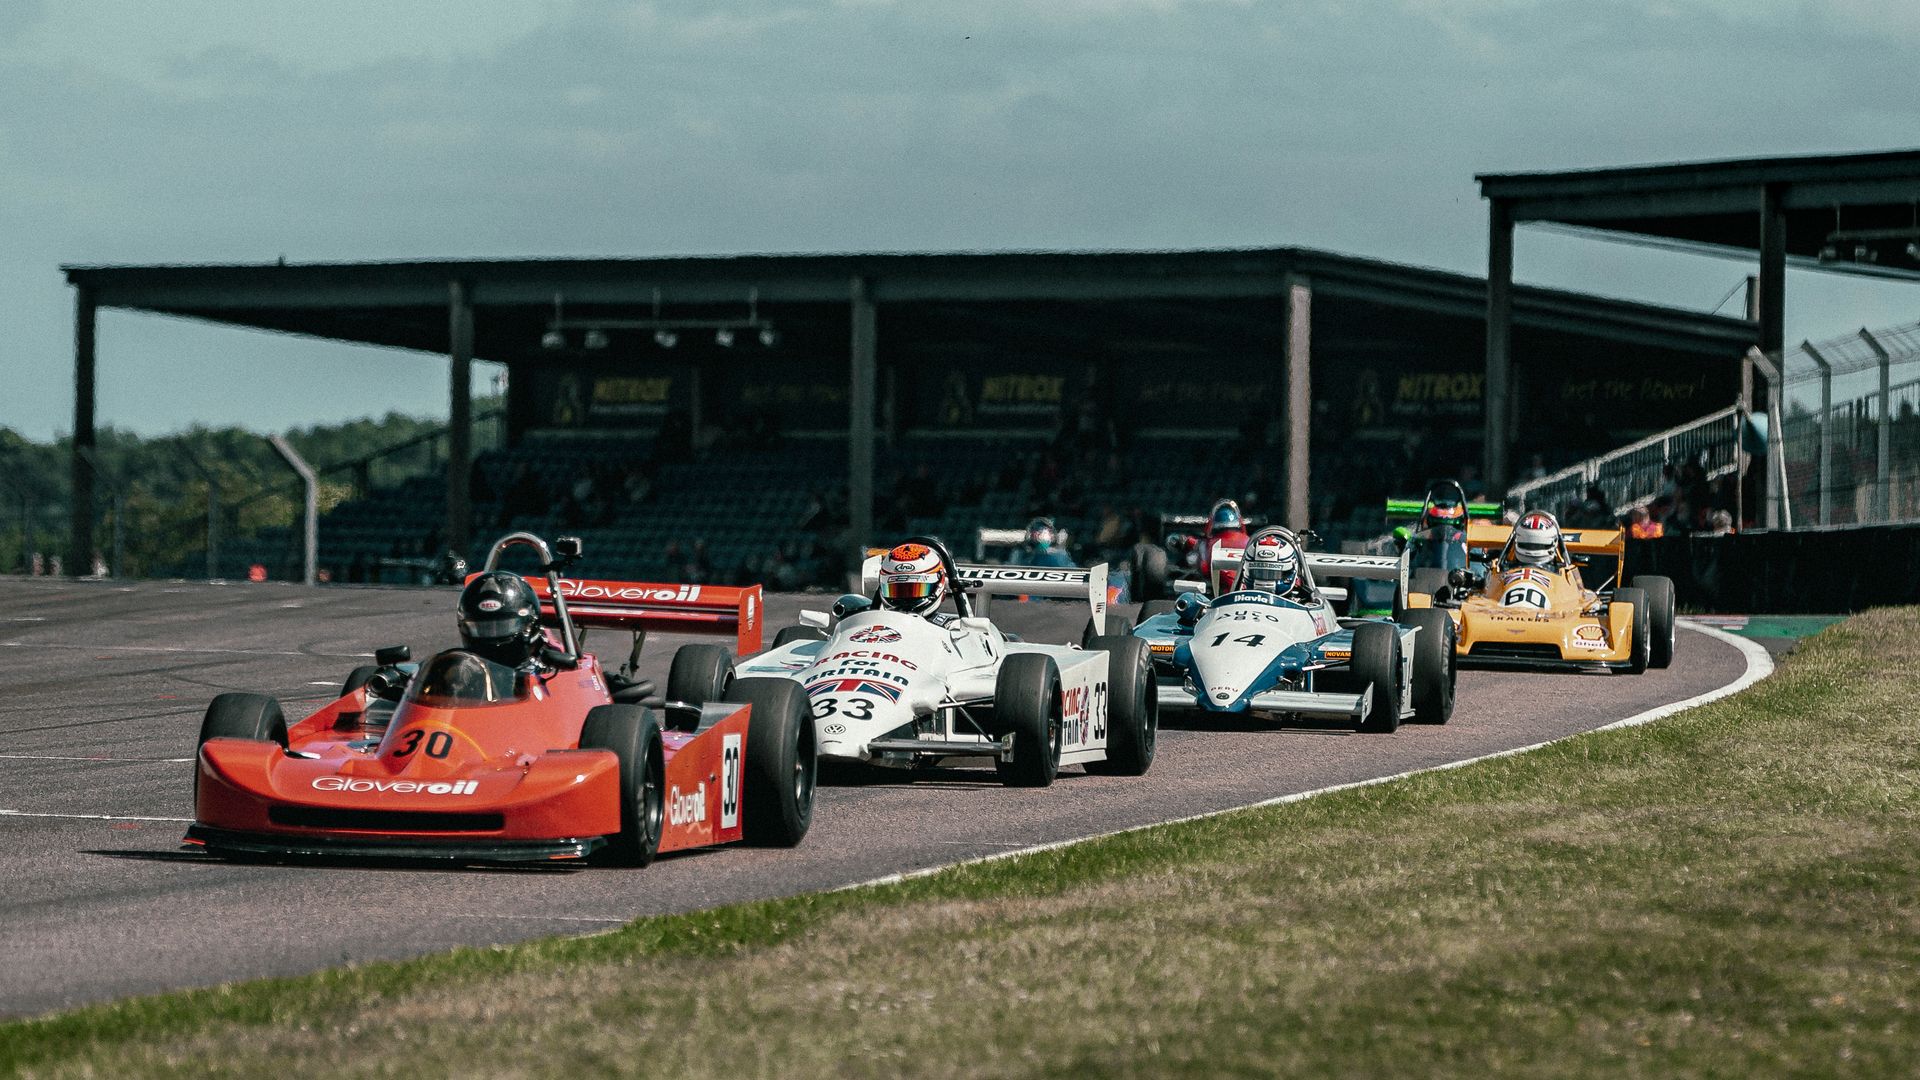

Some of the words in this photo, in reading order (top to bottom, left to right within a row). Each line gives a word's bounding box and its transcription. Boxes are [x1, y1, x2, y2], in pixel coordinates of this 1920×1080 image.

[1398, 372, 1484, 400] NITROX
[959, 568, 1086, 582] THOUSE
[546, 579, 701, 602] Gloveroil
[1505, 588, 1546, 608] 60
[1211, 632, 1266, 648] 14
[813, 650, 918, 671] RACING
[804, 668, 909, 686] BRITAIN
[812, 698, 875, 721] 33
[1061, 687, 1081, 717] CING
[1094, 682, 1107, 740] 33
[1063, 718, 1079, 746] TAIN
[393, 729, 453, 759] 30
[311, 776, 479, 795] Gloveroil
[724, 747, 739, 816] 30
